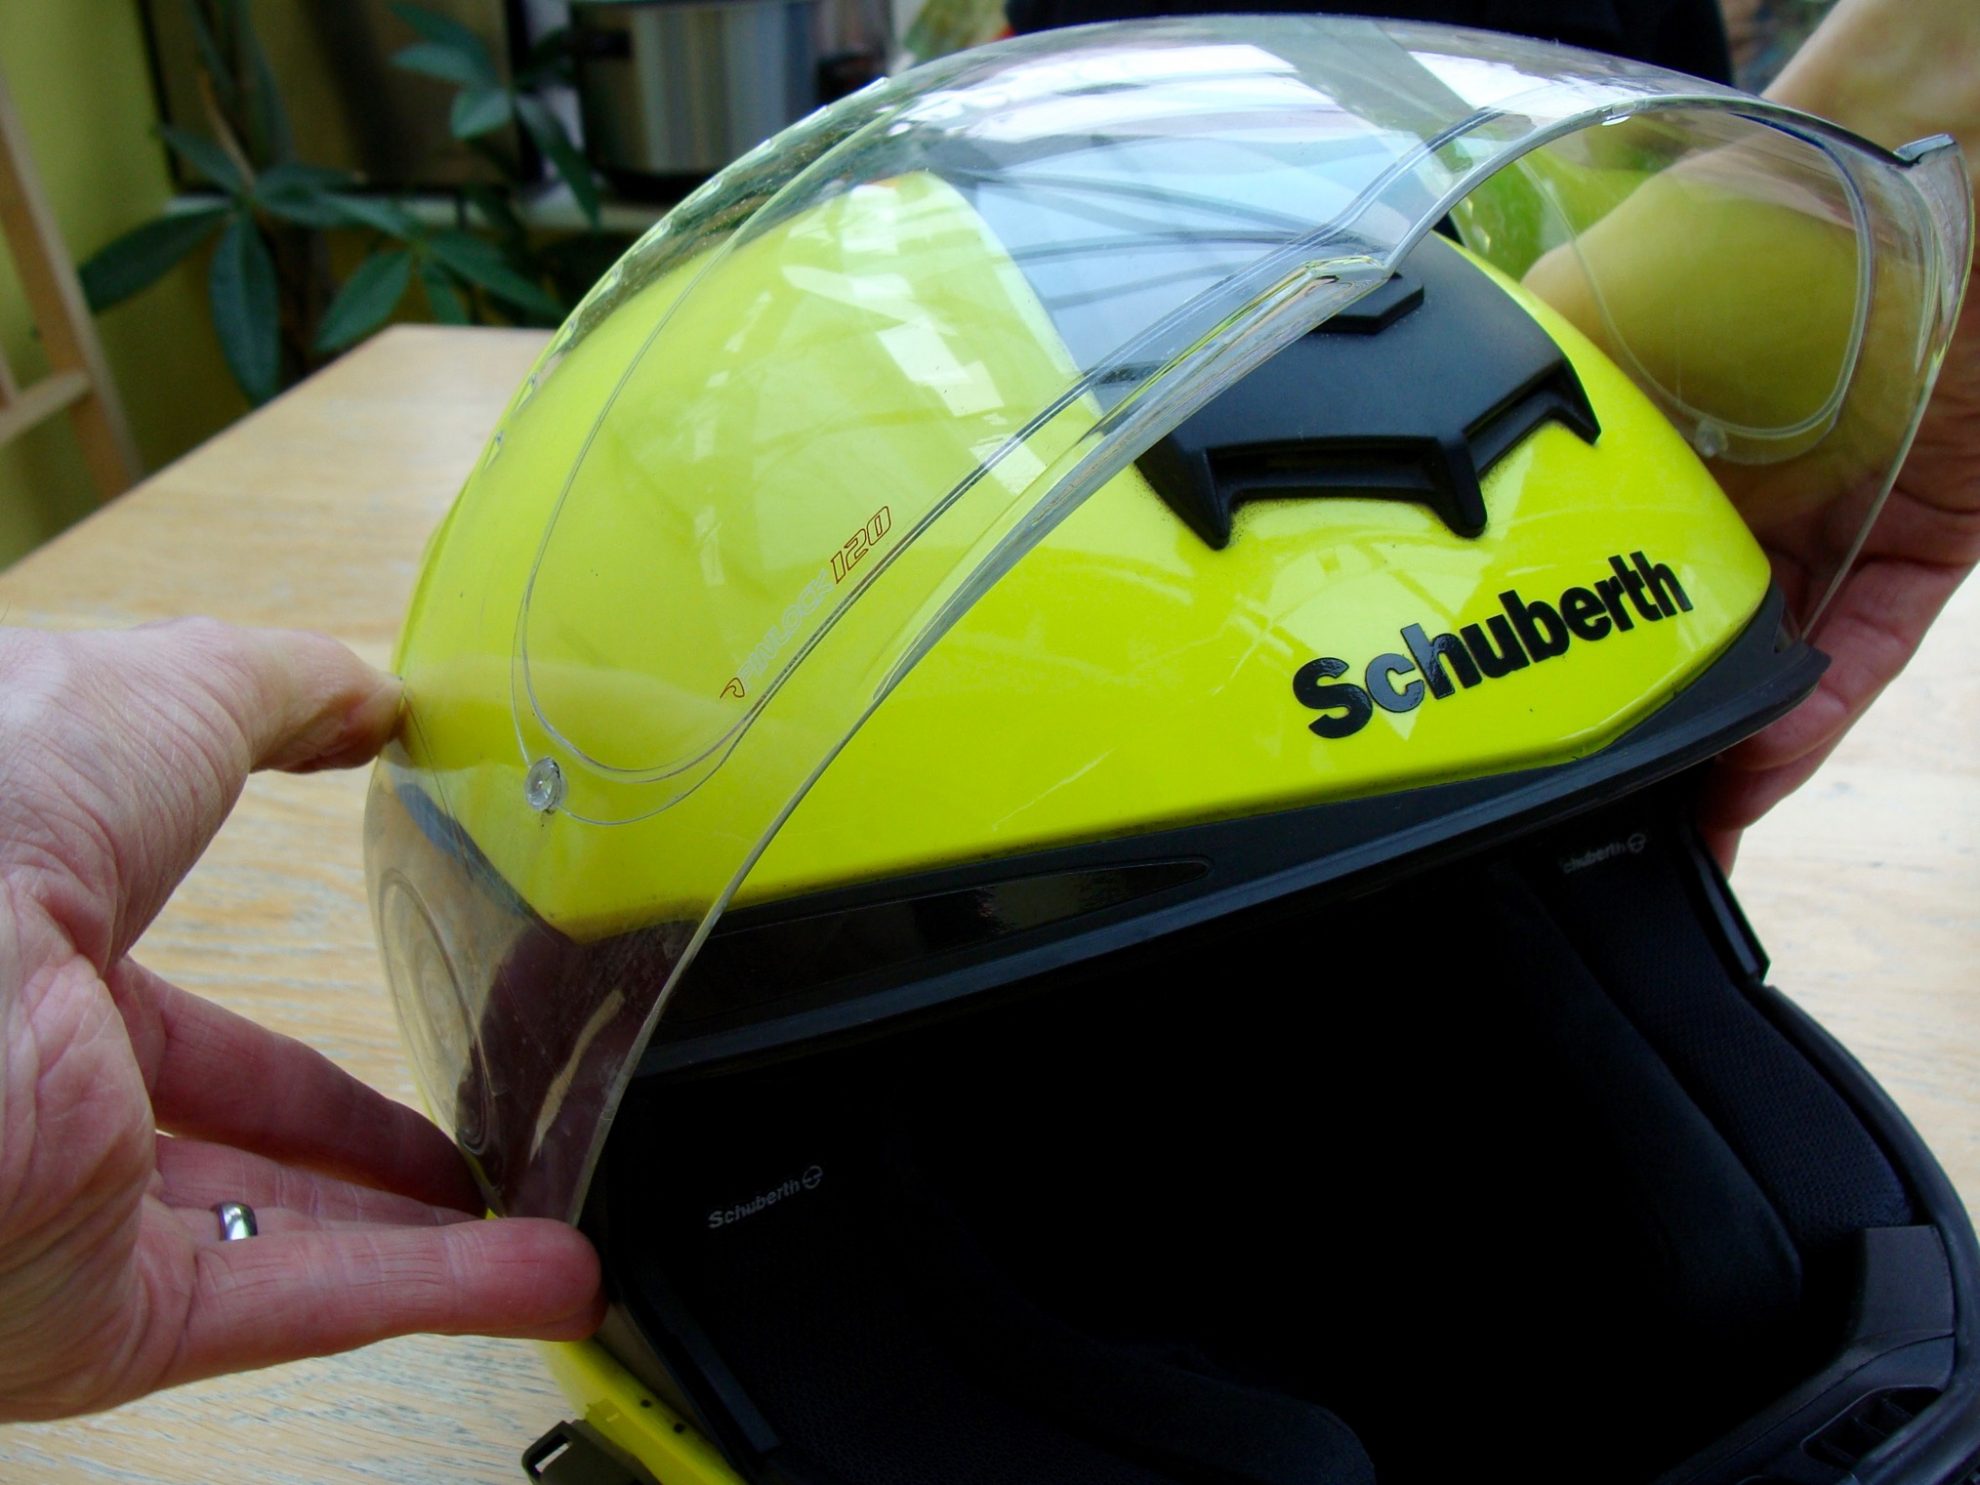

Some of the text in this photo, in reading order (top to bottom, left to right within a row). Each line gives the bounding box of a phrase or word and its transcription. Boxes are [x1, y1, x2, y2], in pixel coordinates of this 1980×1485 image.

[831, 506, 891, 584] 120
[1293, 551, 1693, 738] Schuberth
[708, 1180, 800, 1228] Schuberth
